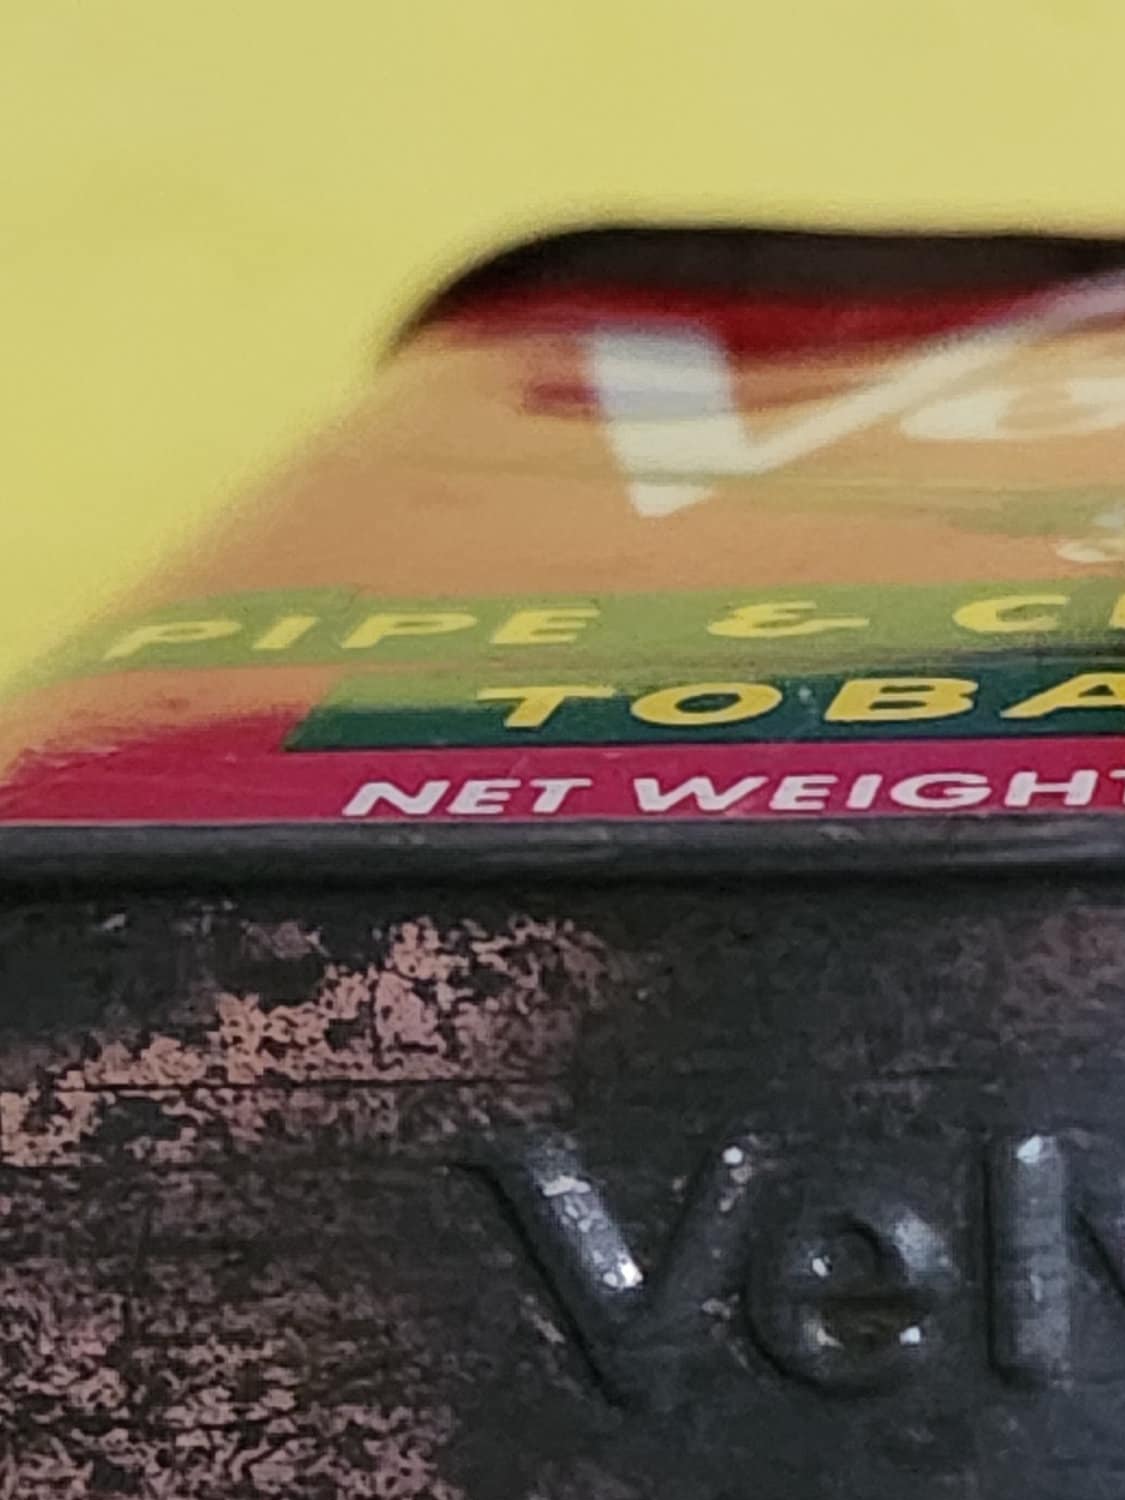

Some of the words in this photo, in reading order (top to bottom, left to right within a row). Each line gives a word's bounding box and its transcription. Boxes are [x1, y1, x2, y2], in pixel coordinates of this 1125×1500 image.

[104, 606, 600, 662] PIPE
[706, 600, 870, 640] &
[340, 778, 592, 818] NET
